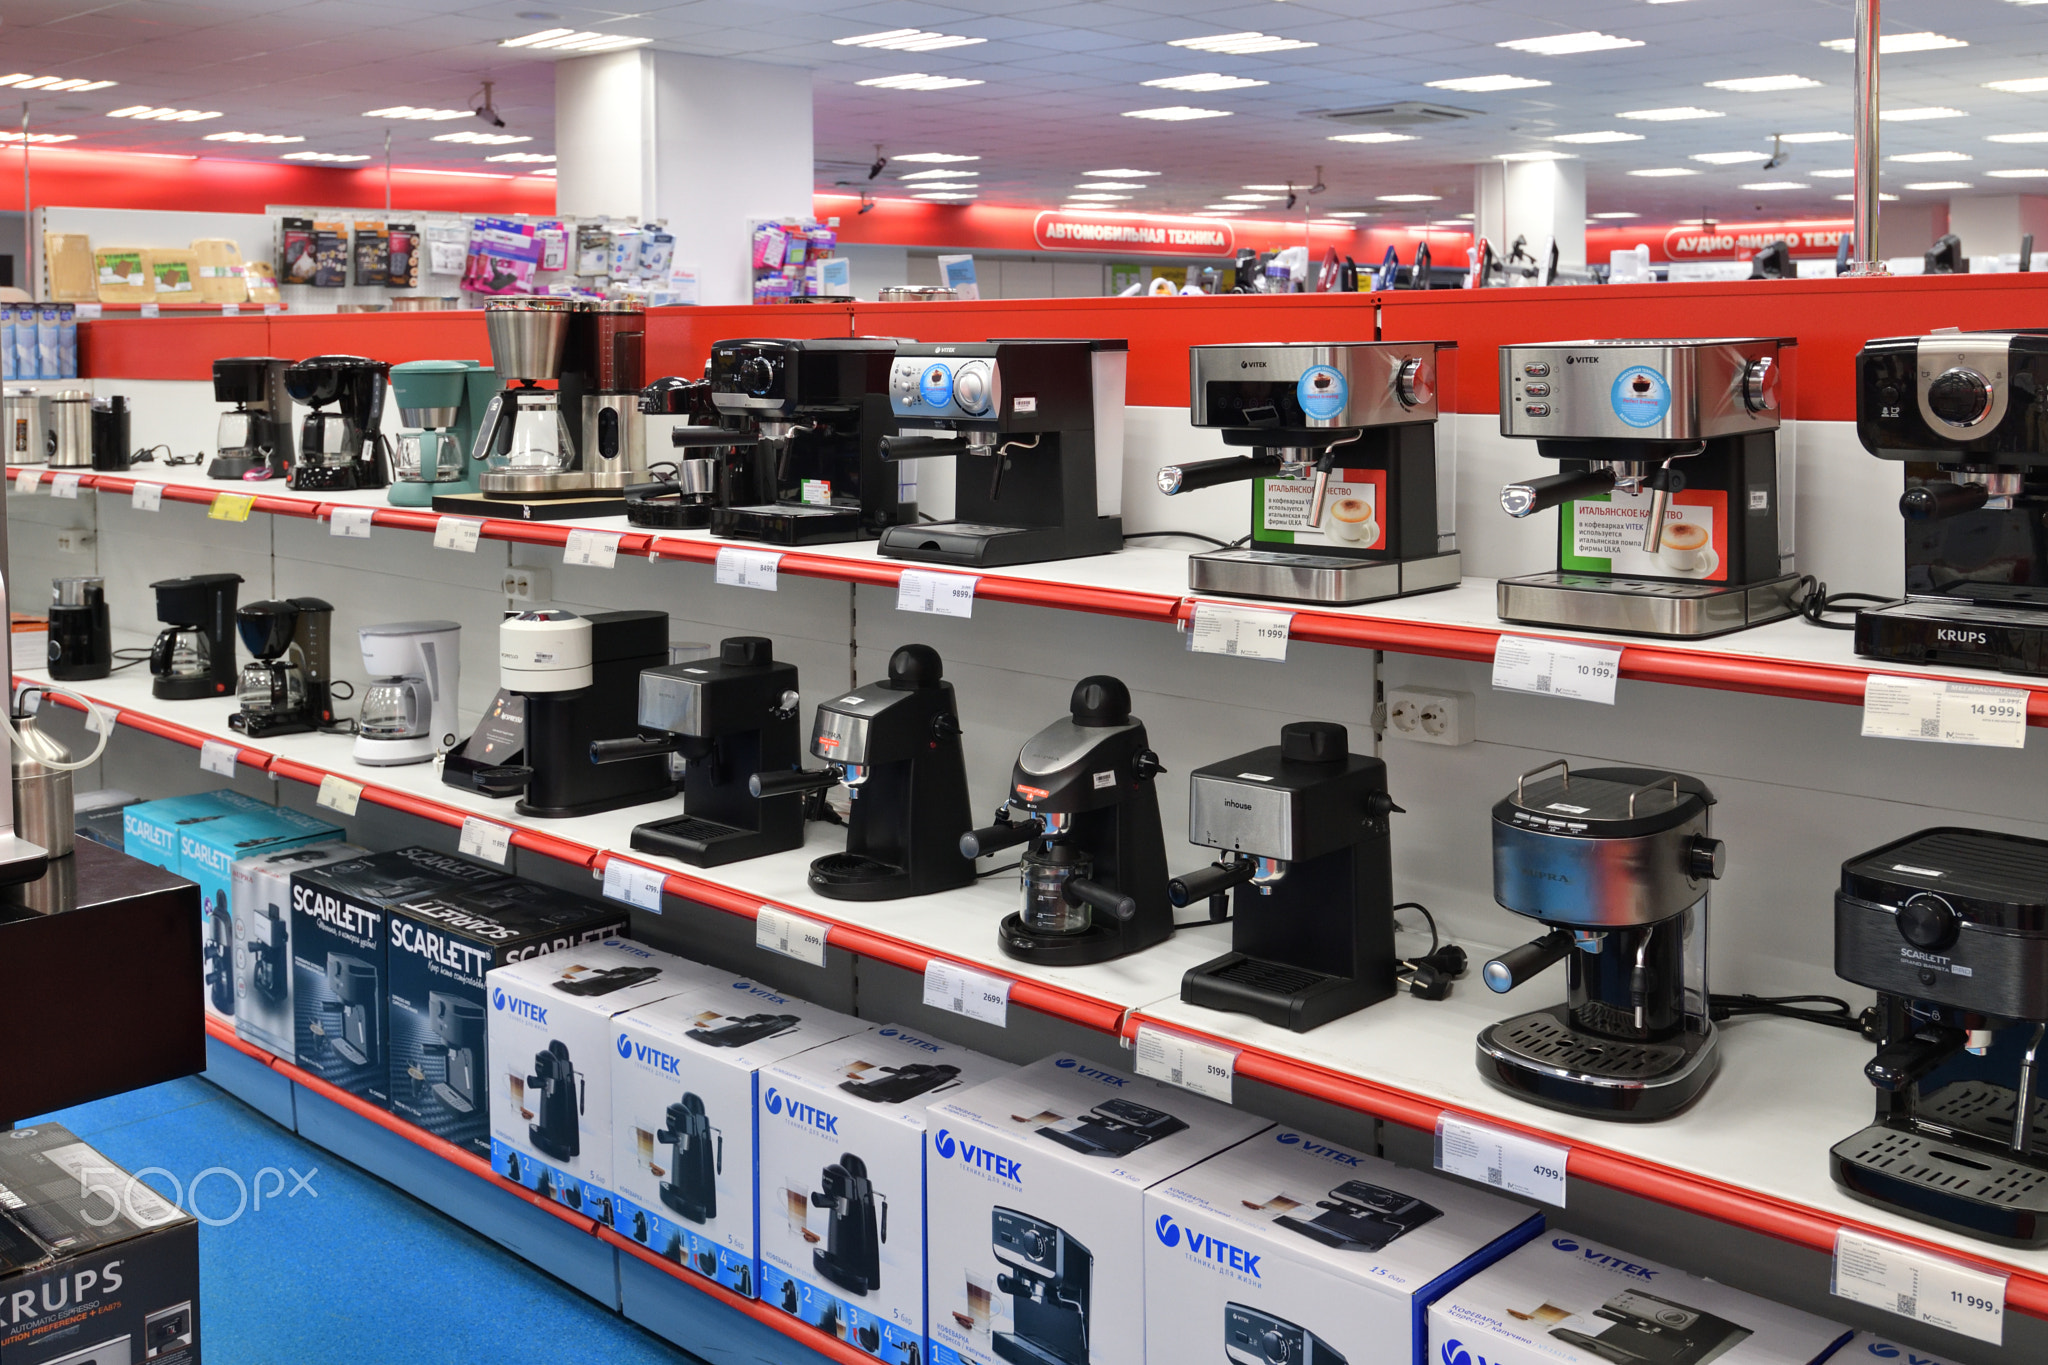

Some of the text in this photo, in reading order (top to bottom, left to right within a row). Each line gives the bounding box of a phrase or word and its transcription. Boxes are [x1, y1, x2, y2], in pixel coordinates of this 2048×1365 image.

[1046, 222, 1225, 246] АВТОМОБИЛЬНАЯ ТЕХНИКА
[1676, 235, 1734, 253] АУДИО
[1326, 486, 1352, 496] ЧЕСТВО
[1268, 505, 1303, 513] используется
[1272, 497, 1305, 506] кофеварках
[1579, 506, 1683, 520] ИТАЛЬЯНСКОЕ КАТВО
[1268, 518, 1302, 526] фирмы ULKA
[1584, 522, 1624, 531] кофеварках
[1579, 529, 1622, 538] используется
[1579, 537, 1619, 545] итальянская
[1258, 628, 1265, 637] 11
[1937, 628, 1987, 644] KRUPS
[1577, 665, 1589, 675] 10
[1971, 704, 1985, 715] 14
[1224, 798, 1252, 811] inhouse
[125, 814, 174, 850] SCARLETT
[618, 944, 656, 959] VITEK
[1900, 947, 1951, 965] SCARLETT
[749, 987, 791, 1005] VITEK
[508, 995, 548, 1025] VITEK
[898, 1033, 946, 1053] VITEK
[635, 1042, 681, 1077] VITEK
[1077, 1064, 1132, 1088] VITEK
[784, 1097, 839, 1136] VITEK
[493, 1141, 499, 1155] 1
[1303, 1139, 1366, 1168] VITEK
[523, 1158, 531, 1172] 2
[959, 1140, 1022, 1184] VITEK
[558, 1173, 564, 1188] 3
[590, 1170, 595, 1180] 5
[959, 1162, 1023, 1193] ТЕХНИКА ДЛЯ ЖИЗНИ
[1110, 1168, 1126, 1177] 15
[583, 1185, 591, 1199] 4
[616, 1199, 623, 1213] 1
[652, 1217, 659, 1232] 2
[691, 1235, 698, 1251] 3
[728, 1234, 733, 1244] 5
[719, 1249, 728, 1266] 4
[765, 1251, 793, 1269] КОФЕВАРКА
[1184, 1227, 1262, 1279] VITEK
[1185, 1252, 1263, 1289] ТЕХНИКА ДЛЯ ЖИЗНИ
[1585, 1248, 1660, 1281] VITEK
[762, 1265, 769, 1282] 1
[1369, 1265, 1406, 1285] 15 бар
[804, 1286, 812, 1304] 2
[1950, 1290, 1963, 1304] 11
[10, 1300, 100, 1335] AUTOMATIC ESPRESSO
[32, 1313, 87, 1337] PREFERENCE
[98, 1301, 122, 1315] EA875
[850, 1308, 858, 1325] 3
[893, 1307, 913, 1326] 5 бар
[1451, 1304, 1503, 1327] КОФЕВАРКА
[883, 1325, 893, 1342] 4
[936, 1322, 970, 1344] КОФЕВАРКА
[1447, 1309, 1485, 1326] эспрессо
[1491, 1325, 1532, 1345] капучино
[932, 1344, 940, 1363] 1
[937, 1331, 992, 1363] эспрессо капучино
